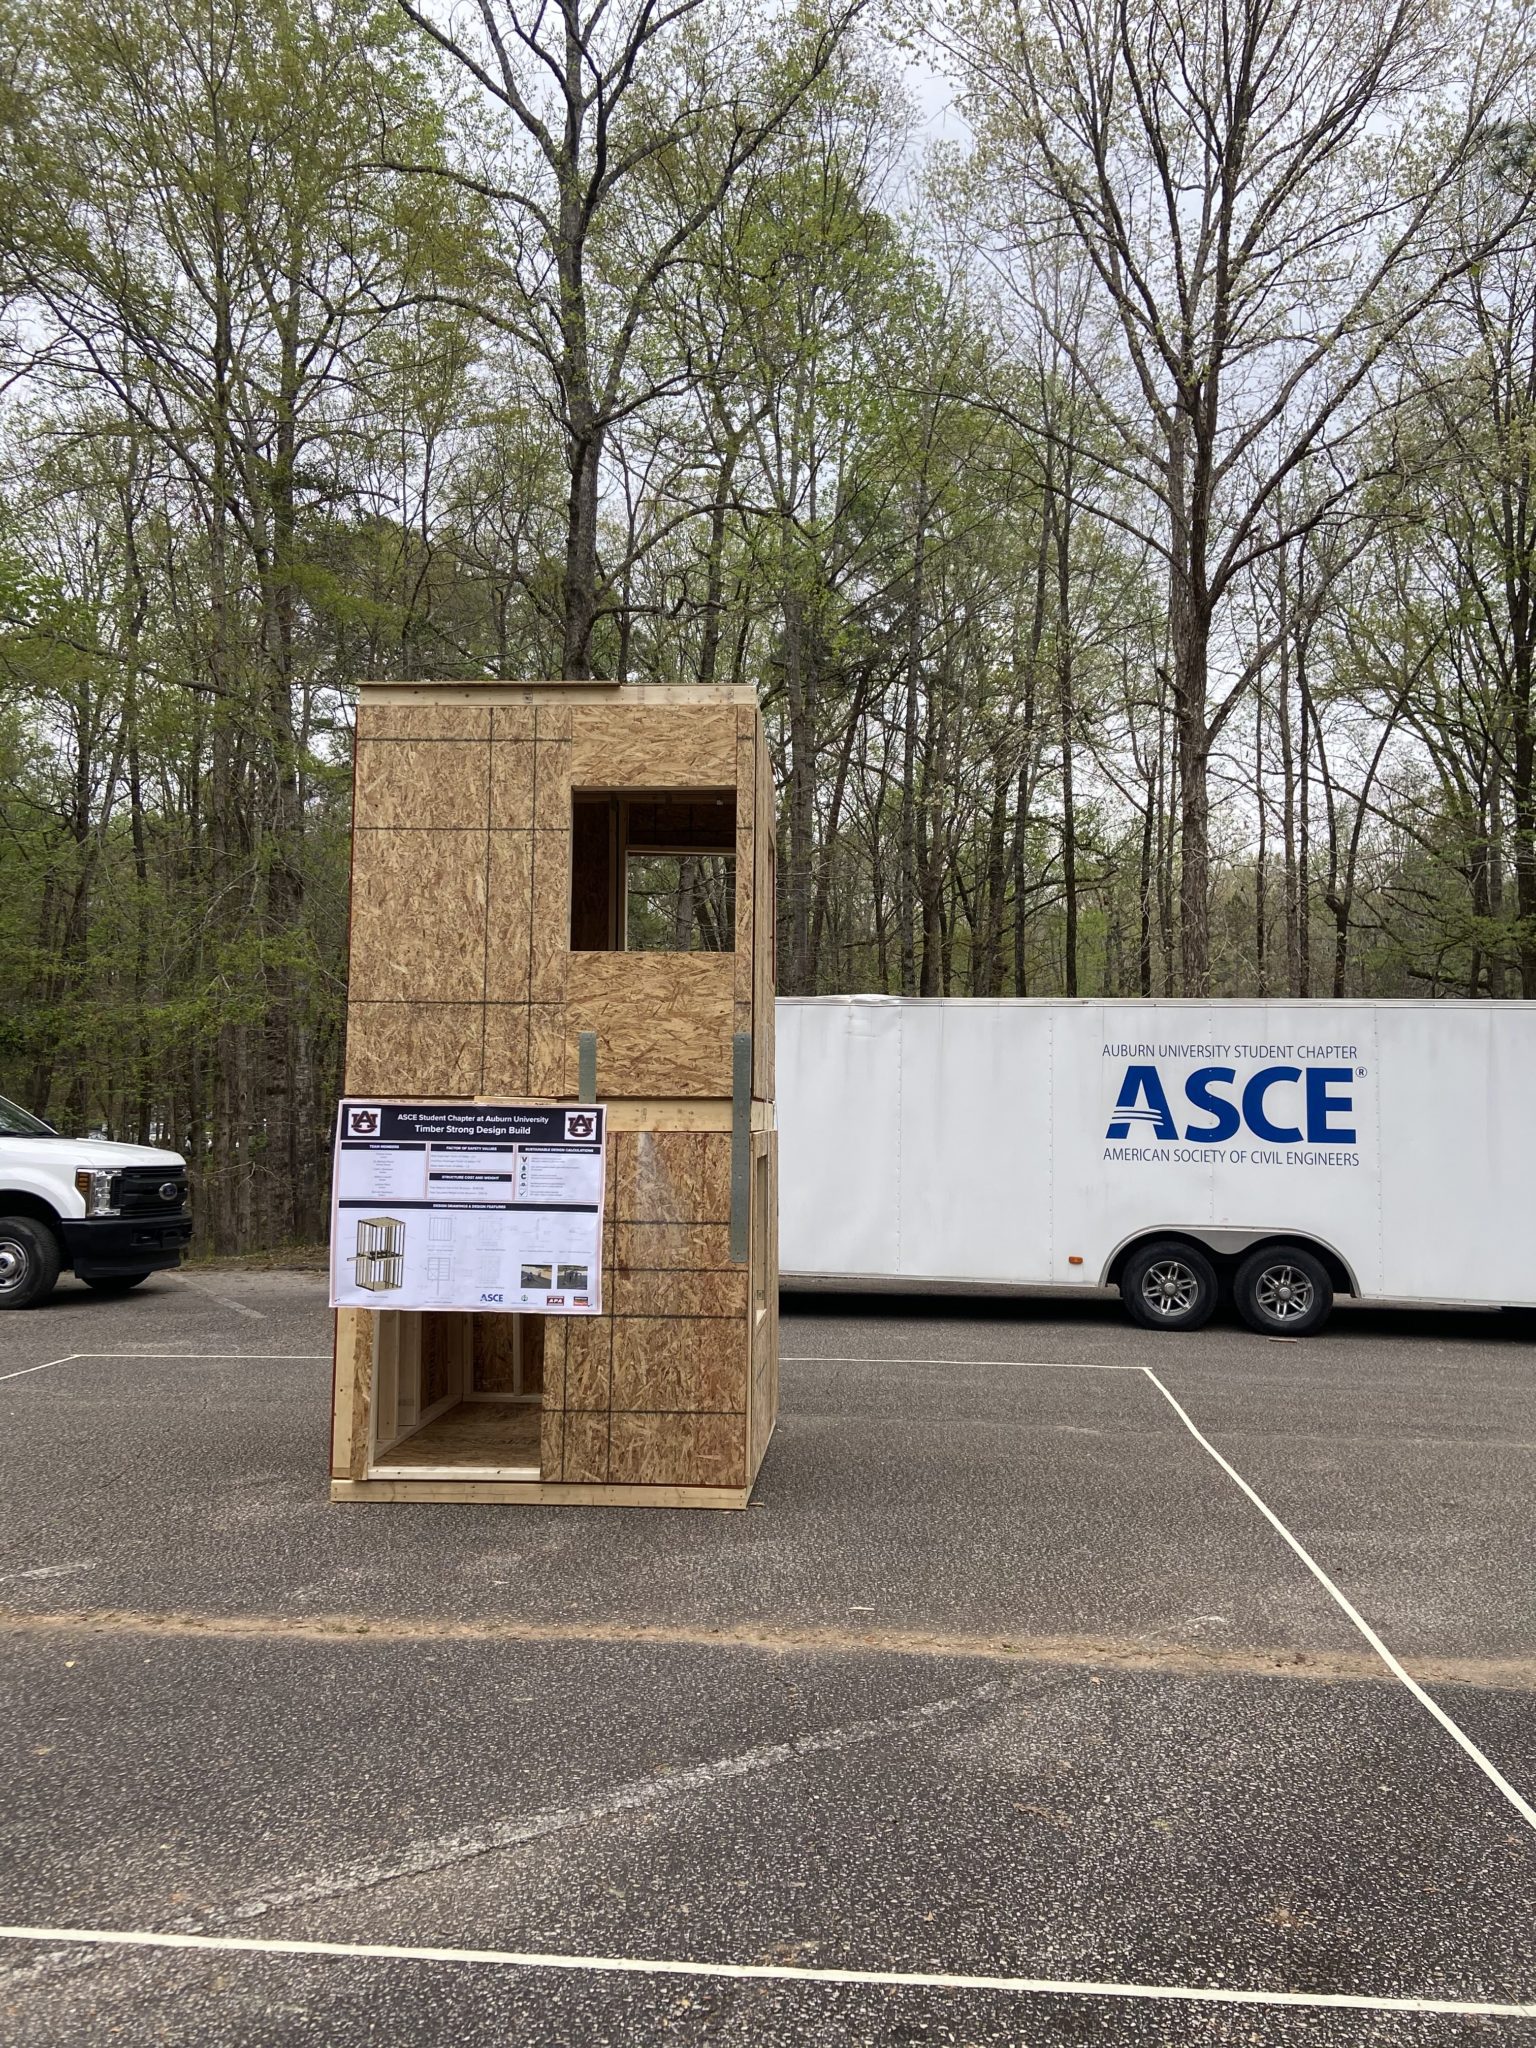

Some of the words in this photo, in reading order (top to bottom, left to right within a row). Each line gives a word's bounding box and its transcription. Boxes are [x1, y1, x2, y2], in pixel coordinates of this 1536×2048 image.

[1102, 1044, 1155, 1057] AUBURN
[1159, 1044, 1231, 1058] UNIVERSITY
[1234, 1045, 1294, 1059] STUDENT
[1297, 1045, 1358, 1059] CHAPTER
[1105, 1065, 1357, 1144] ASCE
[397, 1113, 418, 1121] ASCE
[418, 1114, 446, 1122] Student
[447, 1114, 475, 1123] Chapter
[485, 1115, 512, 1123] Auburn
[513, 1116, 549, 1124] University
[414, 1124, 445, 1133] Timber
[446, 1125, 474, 1135] Strong
[476, 1126, 507, 1136] Design
[508, 1126, 531, 1135] Build
[1103, 1147, 1170, 1162] AMERICAN
[1173, 1149, 1226, 1163] SOCIETY
[1229, 1150, 1247, 1163] OF
[1251, 1151, 1283, 1165] CIVIL
[1286, 1151, 1360, 1166] ENGINEERS
[480, 1294, 504, 1302] ASCE
